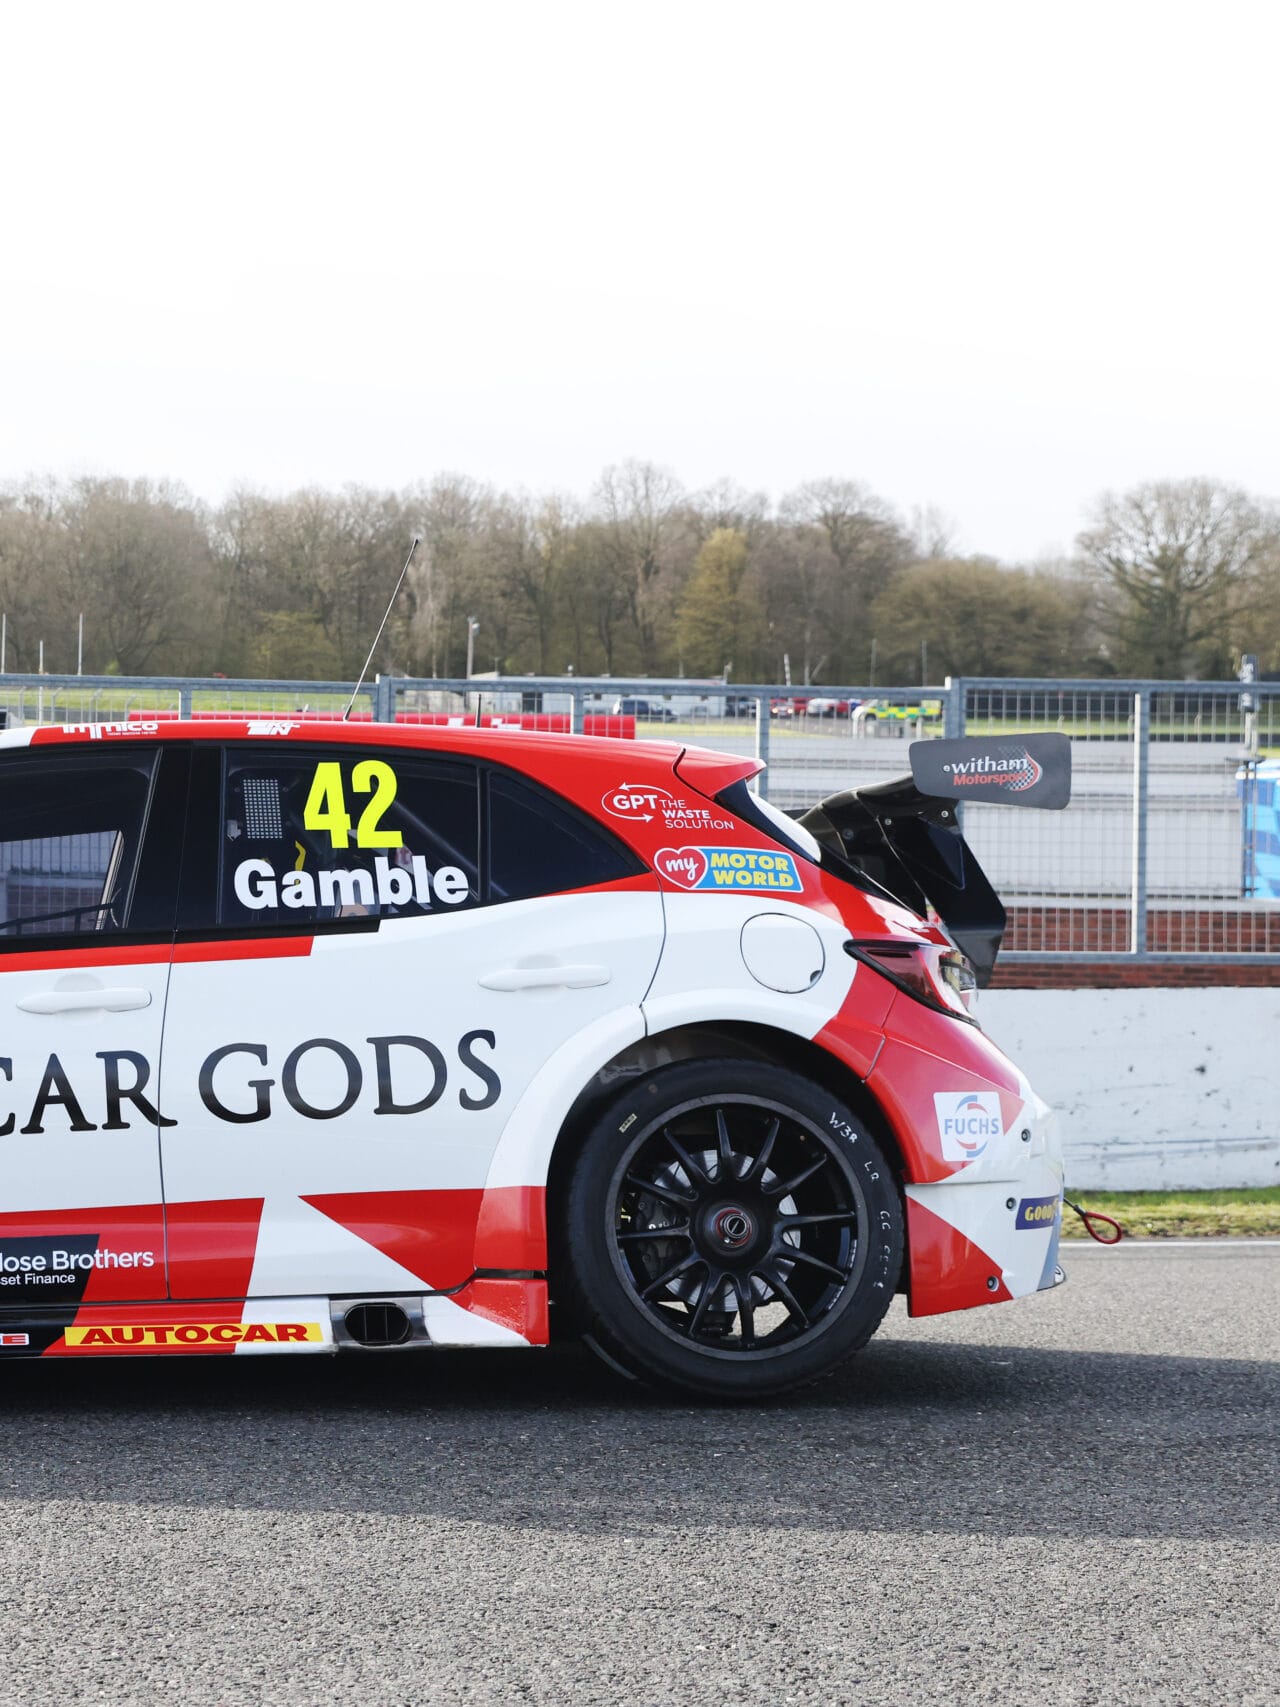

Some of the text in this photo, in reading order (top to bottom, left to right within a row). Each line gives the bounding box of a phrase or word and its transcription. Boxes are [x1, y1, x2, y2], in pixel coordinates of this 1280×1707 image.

[951, 756, 1027, 774] witham
[304, 760, 403, 849] 42
[613, 794, 658, 810] GPT
[659, 799, 687, 809] THE
[662, 809, 711, 819] WASTE
[665, 819, 735, 830] SOLUTION
[665, 856, 699, 881] my
[711, 852, 789, 871] MOTOR
[234, 855, 469, 910] Gamble
[713, 870, 794, 887] WORLD
[198, 1029, 502, 1123] GODS
[944, 1117, 1000, 1135] FUCHS
[52, 1249, 155, 1271] Brothers
[25, 1273, 76, 1285] Finance
[79, 1325, 310, 1346] AUTOCAR
